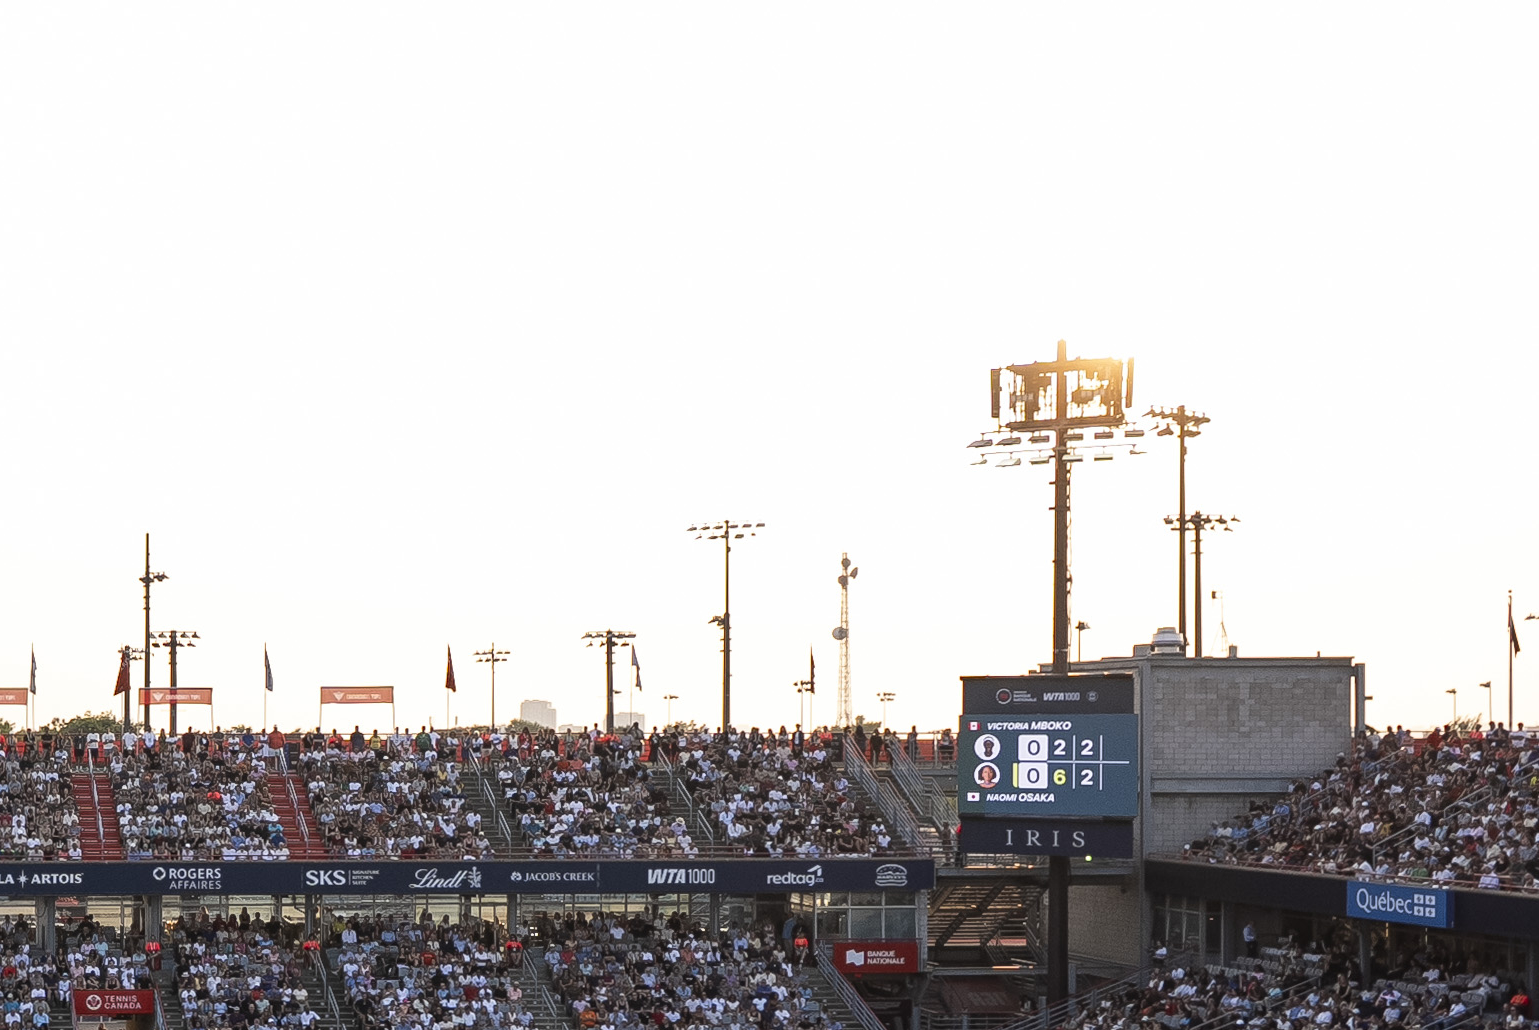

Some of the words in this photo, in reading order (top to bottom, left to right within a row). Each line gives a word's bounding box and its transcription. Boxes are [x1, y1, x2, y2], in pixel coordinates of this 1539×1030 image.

[987, 722, 1029, 731] VICTORIA
[1030, 721, 1071, 730] MBOKO
[1027, 740, 1040, 755] 0
[1053, 740, 1066, 755] 2
[1080, 740, 1093, 755] 2
[1027, 768, 1040, 783] 0
[1053, 769, 1066, 785] 6
[1080, 769, 1093, 785] 2
[986, 793, 1017, 802] NAOMI
[1018, 793, 1055, 802] OSAKA
[31, 873, 83, 885] ARTOIS
[169, 867, 222, 879] ROGERS
[306, 870, 346, 886] SKS
[409, 868, 467, 888] Lindt
[524, 871, 561, 882] JACOB'S
[563, 872, 595, 881] CREEK
[170, 881, 222, 890] AFFAIRES
[1356, 888, 1413, 914] Québec
[104, 1002, 142, 1010] CANADA
